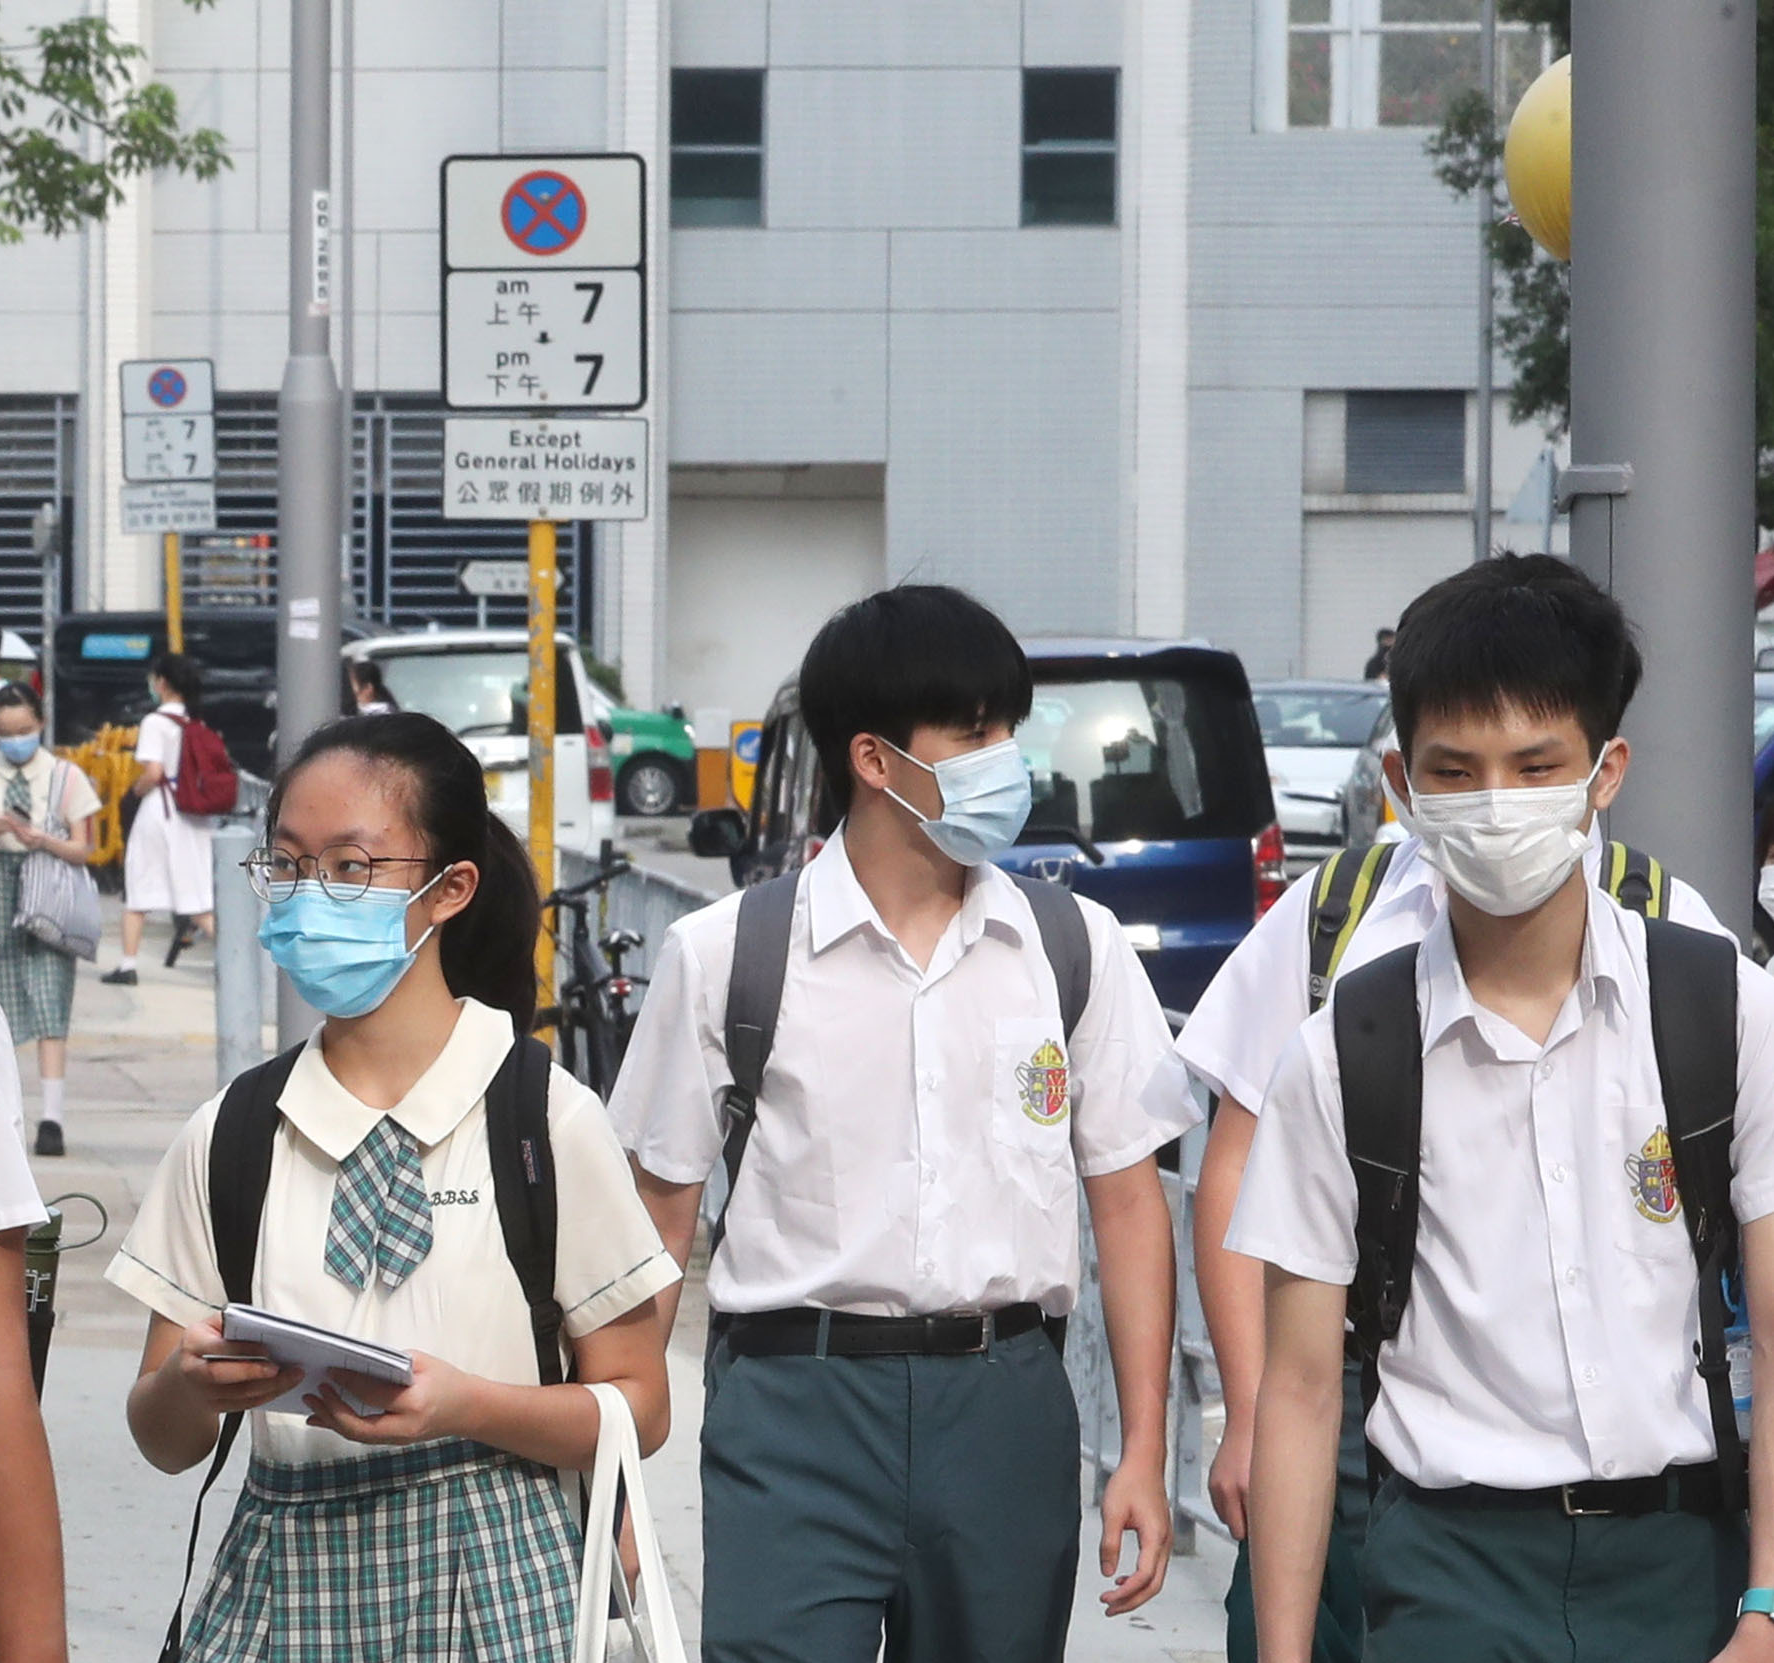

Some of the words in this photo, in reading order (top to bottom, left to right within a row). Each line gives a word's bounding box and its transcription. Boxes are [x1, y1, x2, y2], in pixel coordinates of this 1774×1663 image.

[486, 301, 540, 325] 上午
[496, 280, 529, 294] am
[574, 282, 604, 324] 7
[496, 351, 530, 369] pm
[574, 354, 604, 396] 7
[486, 374, 540, 397] 下午
[182, 420, 196, 439] 7
[510, 430, 581, 449] Except
[183, 454, 197, 474] 7
[455, 453, 536, 470] General
[545, 452, 636, 473] Holidays
[457, 480, 634, 505] 公眾假期例外
